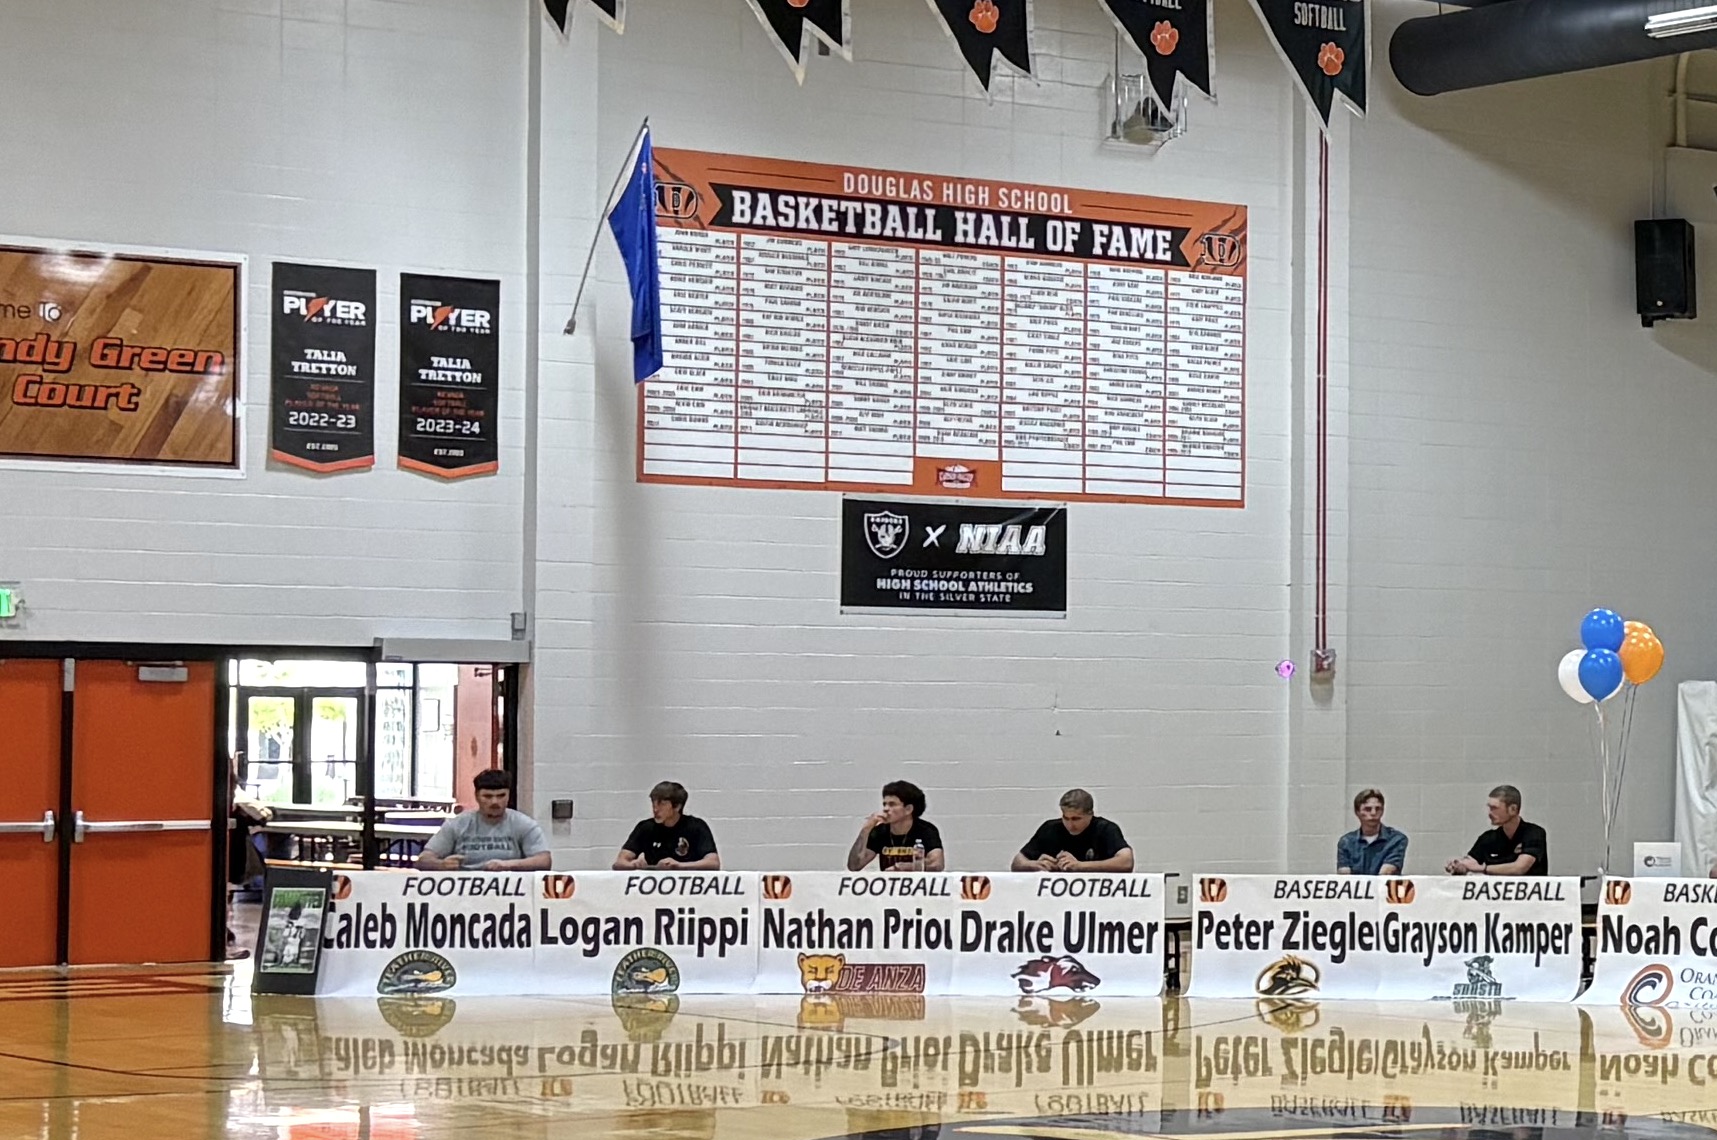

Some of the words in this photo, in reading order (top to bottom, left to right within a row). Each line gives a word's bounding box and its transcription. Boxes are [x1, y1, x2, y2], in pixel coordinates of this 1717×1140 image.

[1293, 2, 1347, 31] SOFTBALL
[843, 172, 934, 201] DOUGLAS
[942, 180, 991, 206] HIGH
[997, 185, 1073, 215] SCHOOL
[731, 189, 942, 243] BASKETBALL
[955, 214, 1035, 249] HALL
[1045, 221, 1080, 252] OF
[1091, 225, 1172, 261] FAME
[90, 337, 224, 374] Green
[304, 349, 346, 362] TALIA
[430, 357, 471, 369] TALIA
[291, 361, 357, 376] TRETTON
[418, 369, 482, 383] TRETTON
[13, 374, 141, 411] Court
[289, 411, 356, 428] 2022-23
[416, 418, 480, 434] 2023-24
[955, 524, 1046, 555] NIAA
[876, 578, 911, 590] HIGH
[913, 579, 965, 592] SCHOOL
[968, 581, 1033, 593] ATHLETICS
[891, 569, 928, 578] PROUD
[932, 570, 1003, 580] SUPPORTERS
[1006, 572, 1020, 581] OF
[899, 592, 910, 600] IN
[915, 592, 934, 601] THE
[939, 593, 975, 602] SILVER
[980, 594, 1011, 603] STATE
[402, 876, 527, 897] FOOTBALL
[624, 876, 745, 896] FOOTBALL
[838, 877, 951, 897] FOOTBALL
[1037, 878, 1152, 898] FOOTBALL
[1273, 880, 1375, 900] BASEBALL
[1462, 882, 1566, 901] BASEBALL
[405, 902, 532, 949] Moncada
[539, 909, 643, 958] Logan
[654, 907, 749, 958] Riippi
[763, 908, 873, 951] Nathan
[960, 910, 1054, 954] Drake
[1063, 911, 1159, 954] Ulmer
[1197, 911, 1275, 951] Peter
[1601, 914, 1681, 956] Noah
[1383, 912, 1478, 967] Grayson
[1484, 913, 1574, 967] Kamper
[837, 965, 865, 991] DE
[869, 965, 925, 992] ANZA
